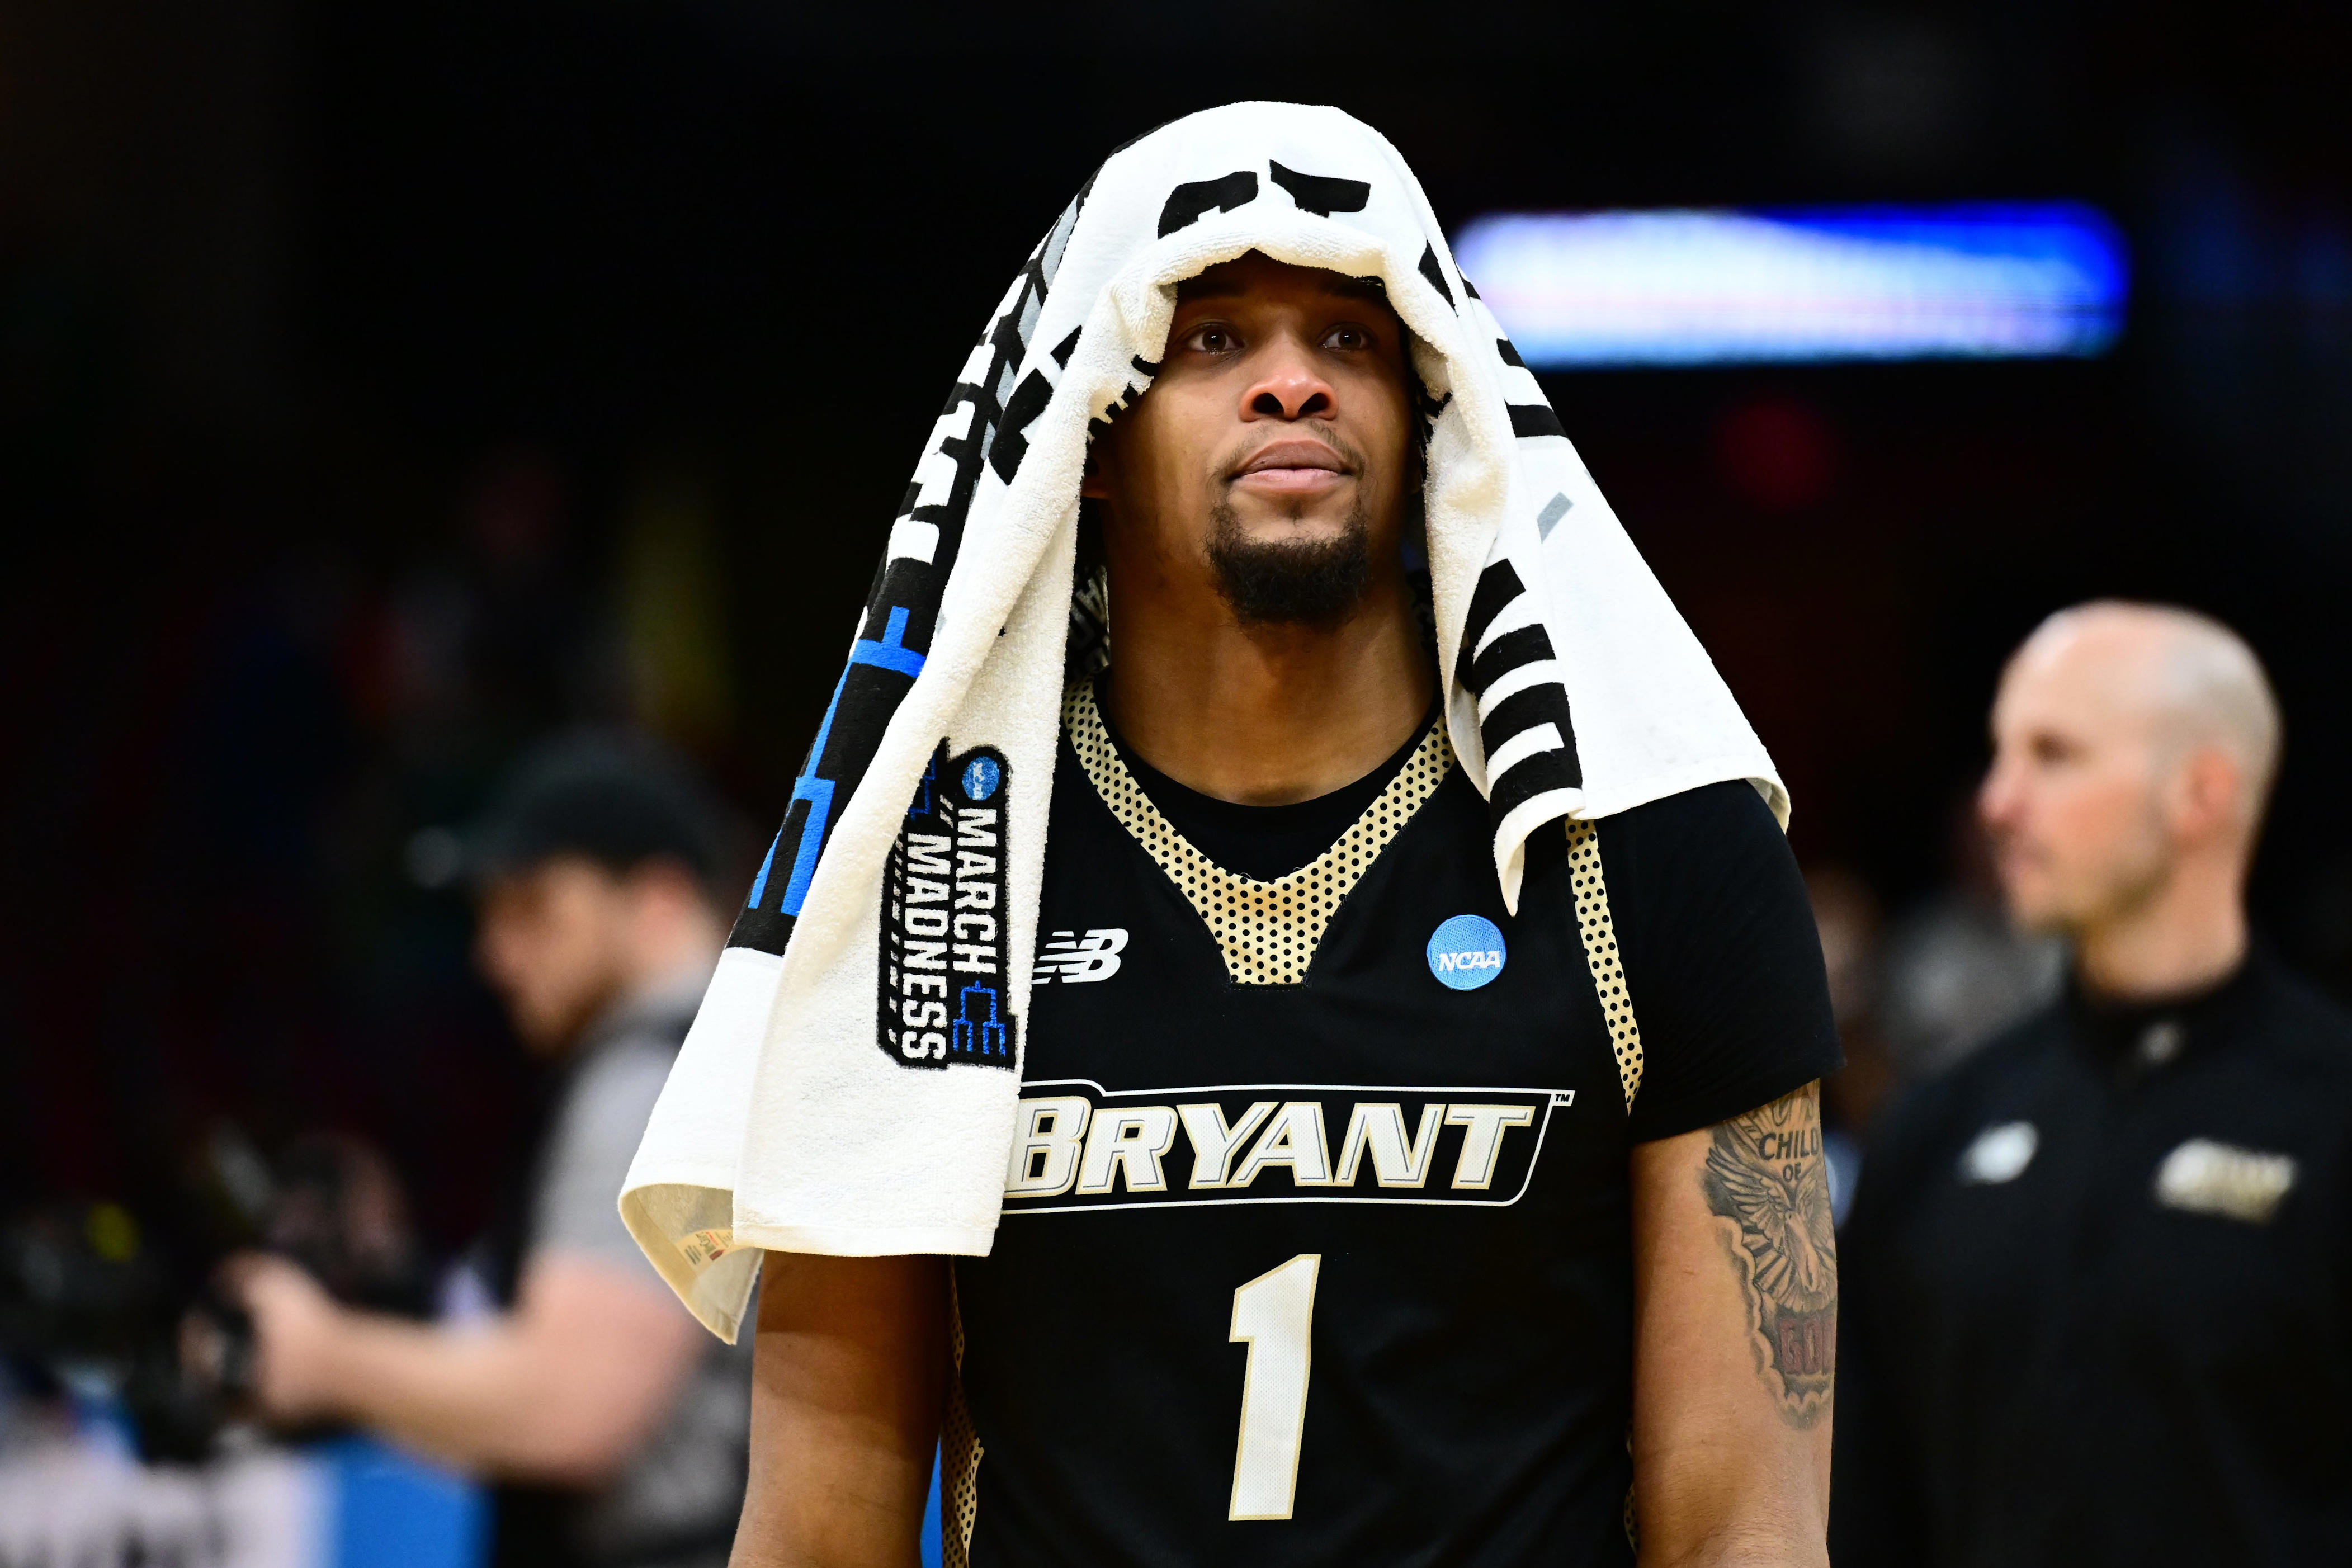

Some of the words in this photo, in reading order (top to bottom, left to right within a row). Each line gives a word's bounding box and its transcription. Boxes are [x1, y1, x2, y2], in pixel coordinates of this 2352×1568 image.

[952, 808, 998, 974] MARCH
[901, 833, 951, 1060] MADNESS
[1032, 928, 1129, 985] NB
[1438, 950, 1501, 971] NCAA
[1003, 1095, 1536, 1198] BRYANT
[1555, 1094, 1570, 1102] TM
[1759, 1126, 1820, 1160] CHILD
[1783, 1161, 1802, 1182] OF
[1228, 1254, 1322, 1521] 1
